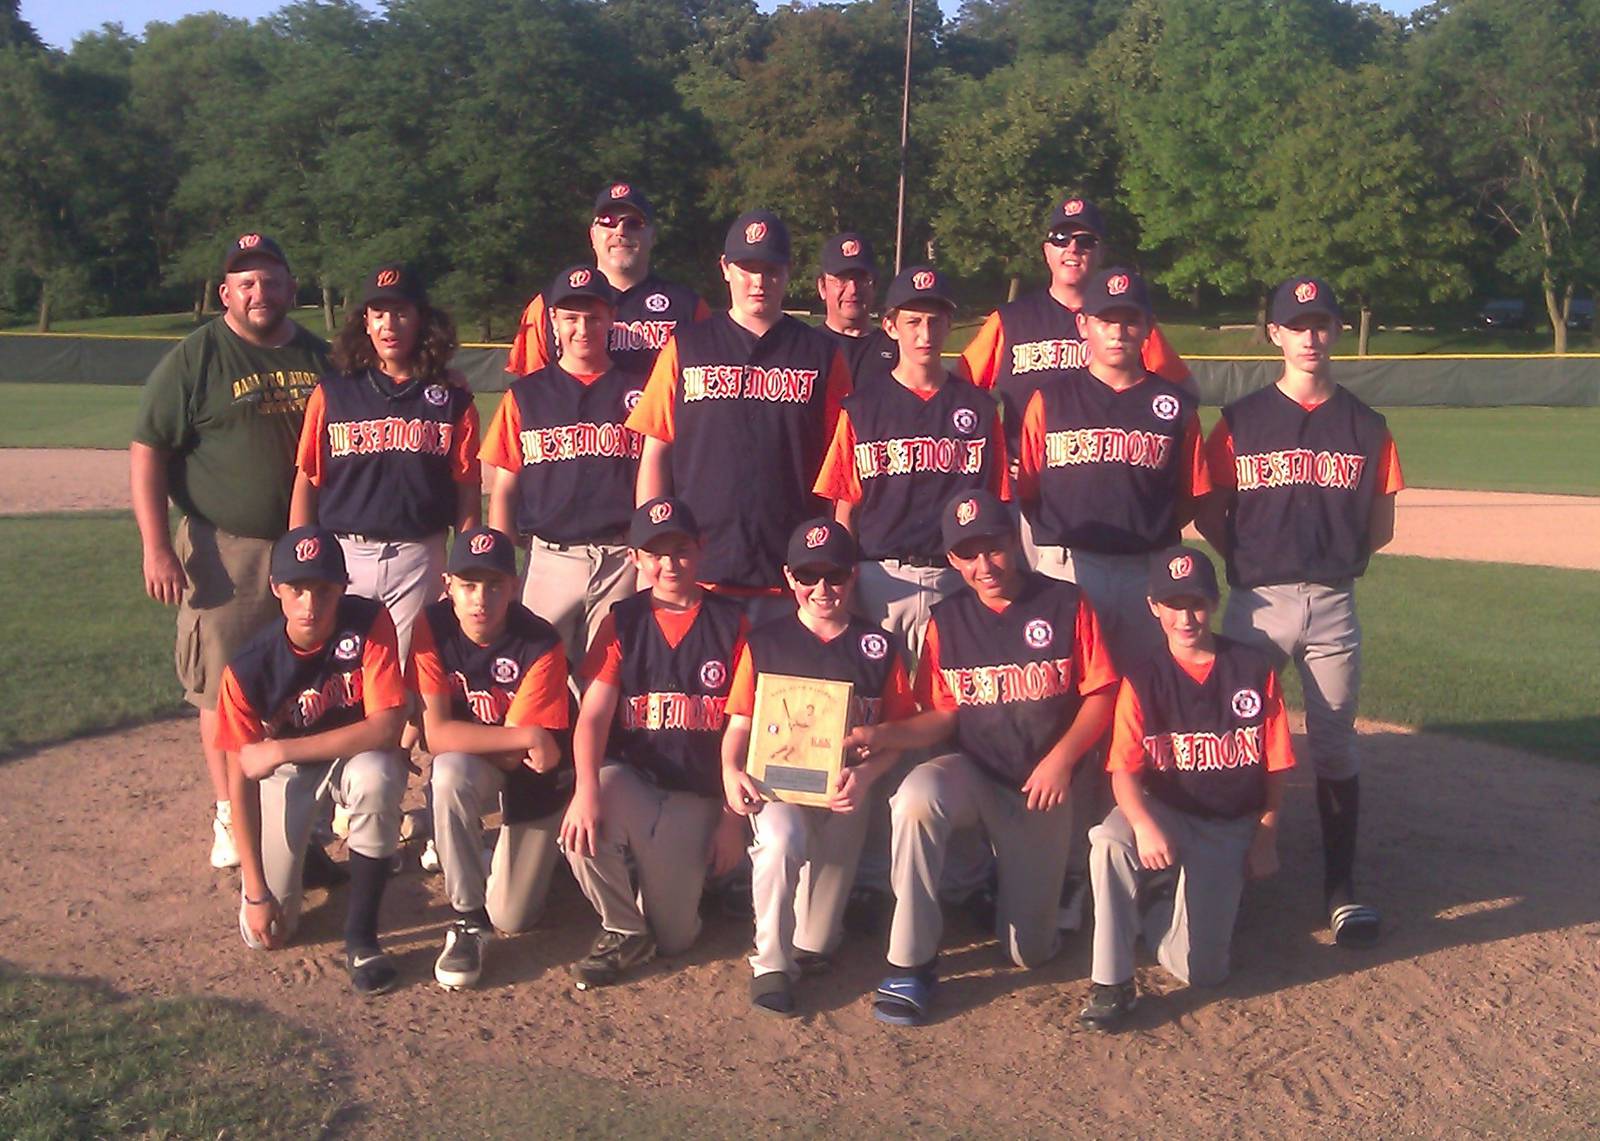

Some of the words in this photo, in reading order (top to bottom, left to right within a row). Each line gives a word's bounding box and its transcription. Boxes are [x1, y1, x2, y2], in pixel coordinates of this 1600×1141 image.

[608, 320, 677, 351] MONT
[1012, 339, 1091, 375] WESTMO
[683, 365, 819, 403] WESTMONT
[328, 417, 455, 458] WESTMONT
[1046, 428, 1172, 468] WESTMONT
[856, 437, 986, 479] WESTMONT
[1236, 448, 1366, 491] WESTMONT
[1142, 723, 1265, 772] WSTMON
